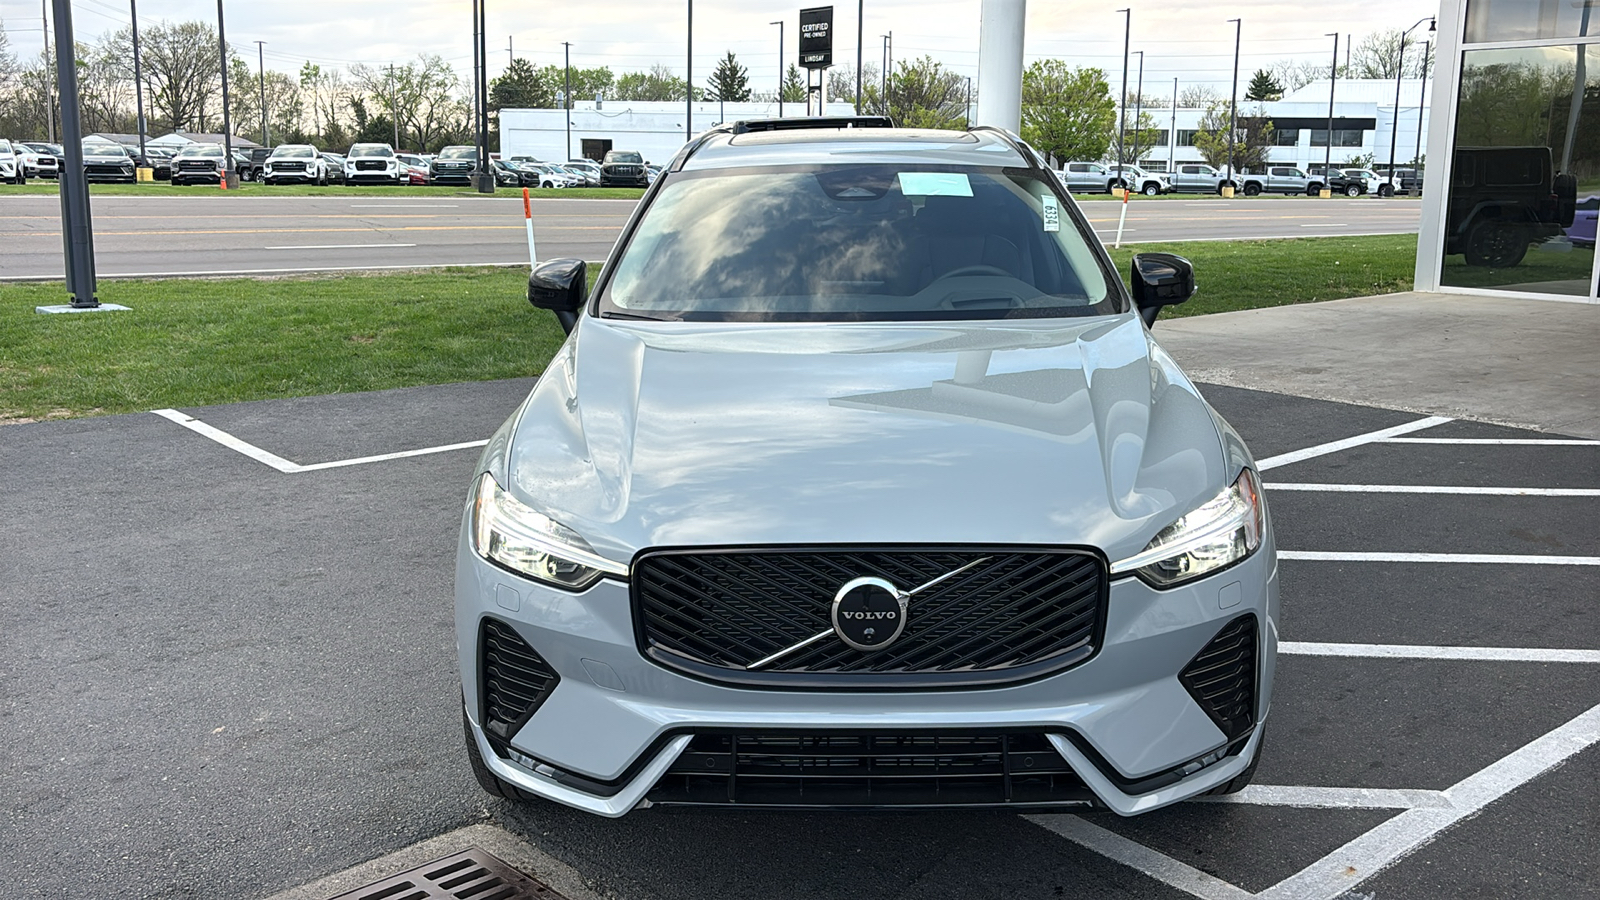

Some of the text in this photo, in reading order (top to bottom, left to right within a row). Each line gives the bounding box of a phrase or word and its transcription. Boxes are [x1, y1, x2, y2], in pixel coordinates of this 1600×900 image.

[801, 22, 829, 33] CERTIFIED
[803, 31, 827, 39] PRE-OWNED
[804, 55, 825, 63] LINDSAY
[1044, 205, 1058, 225] 6334
[842, 611, 896, 620] VOLVO
